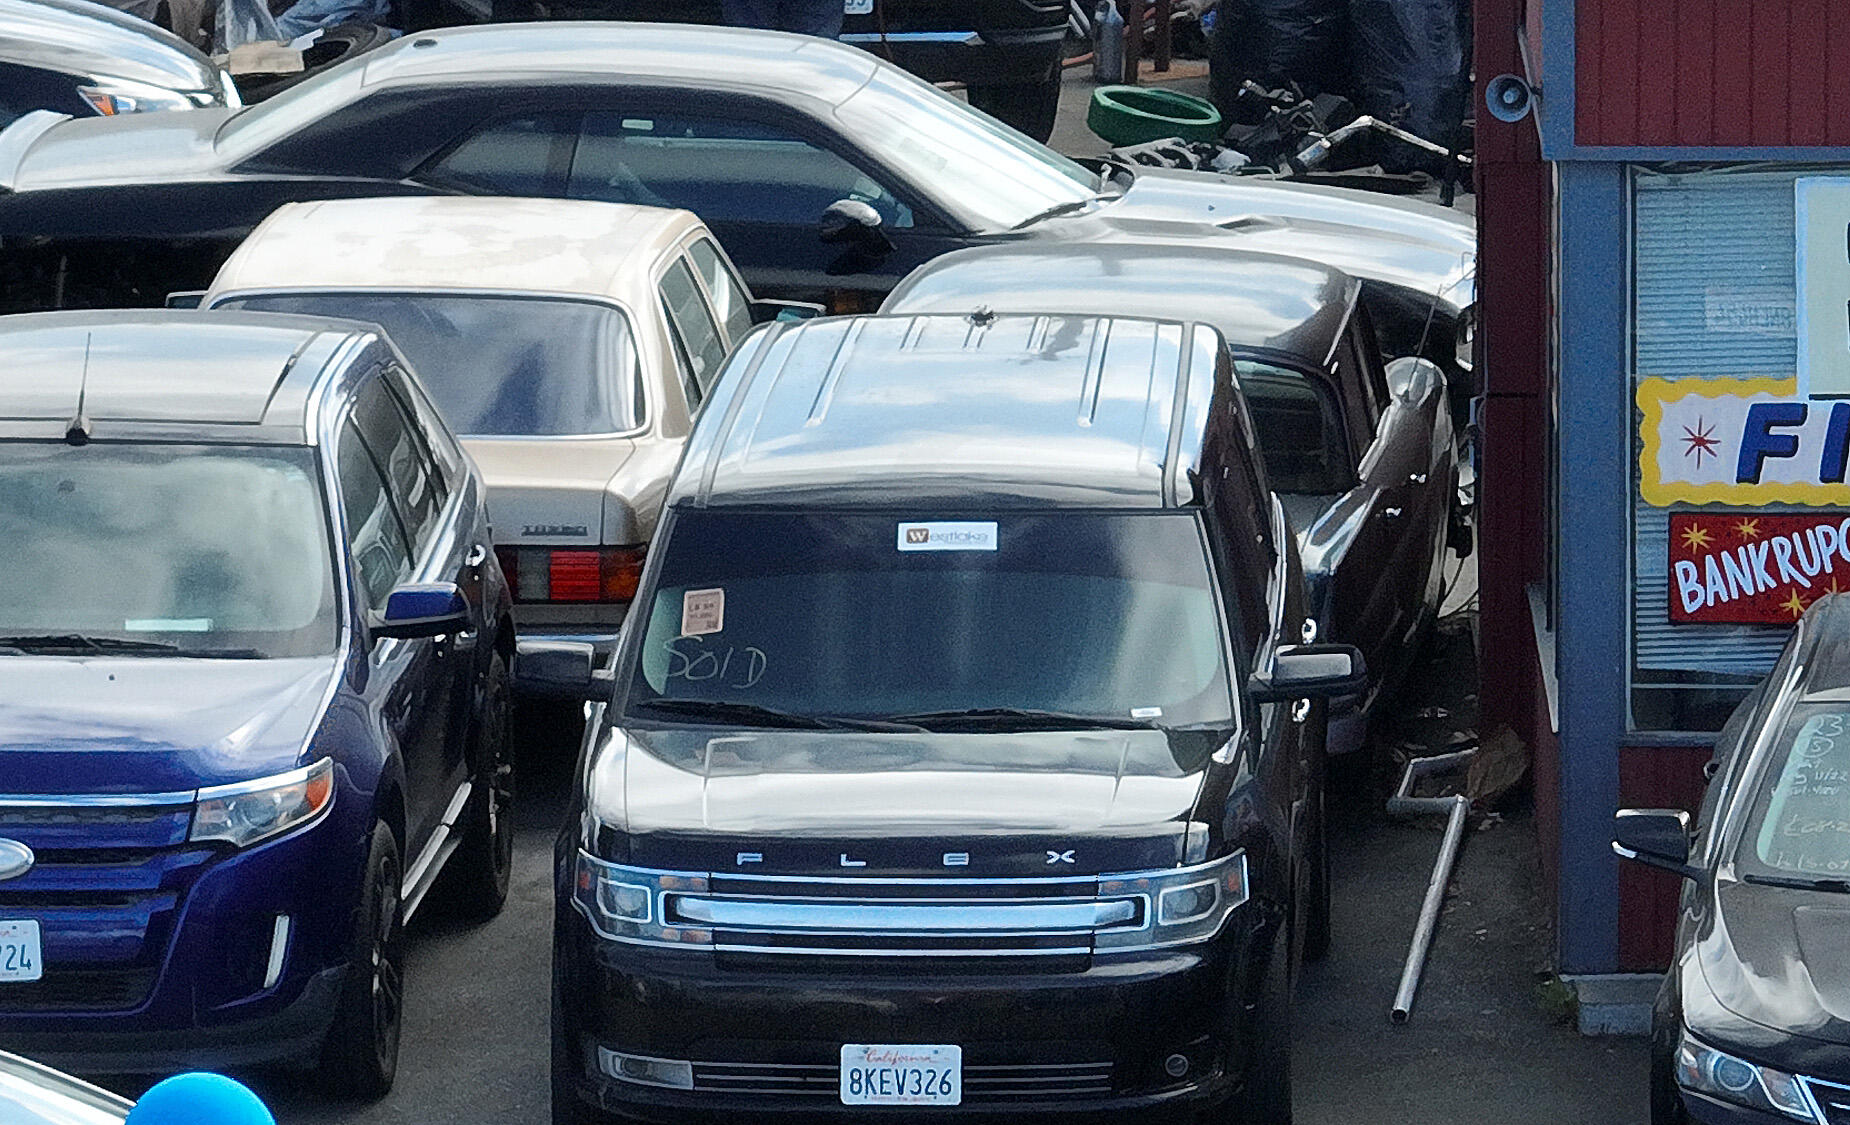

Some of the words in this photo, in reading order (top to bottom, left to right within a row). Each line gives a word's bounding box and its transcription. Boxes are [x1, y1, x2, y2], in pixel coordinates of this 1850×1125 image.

[736, 850, 1076, 866] FLEX
[0, 944, 31, 970] 24
[849, 1067, 952, 1096] 8KEV326
